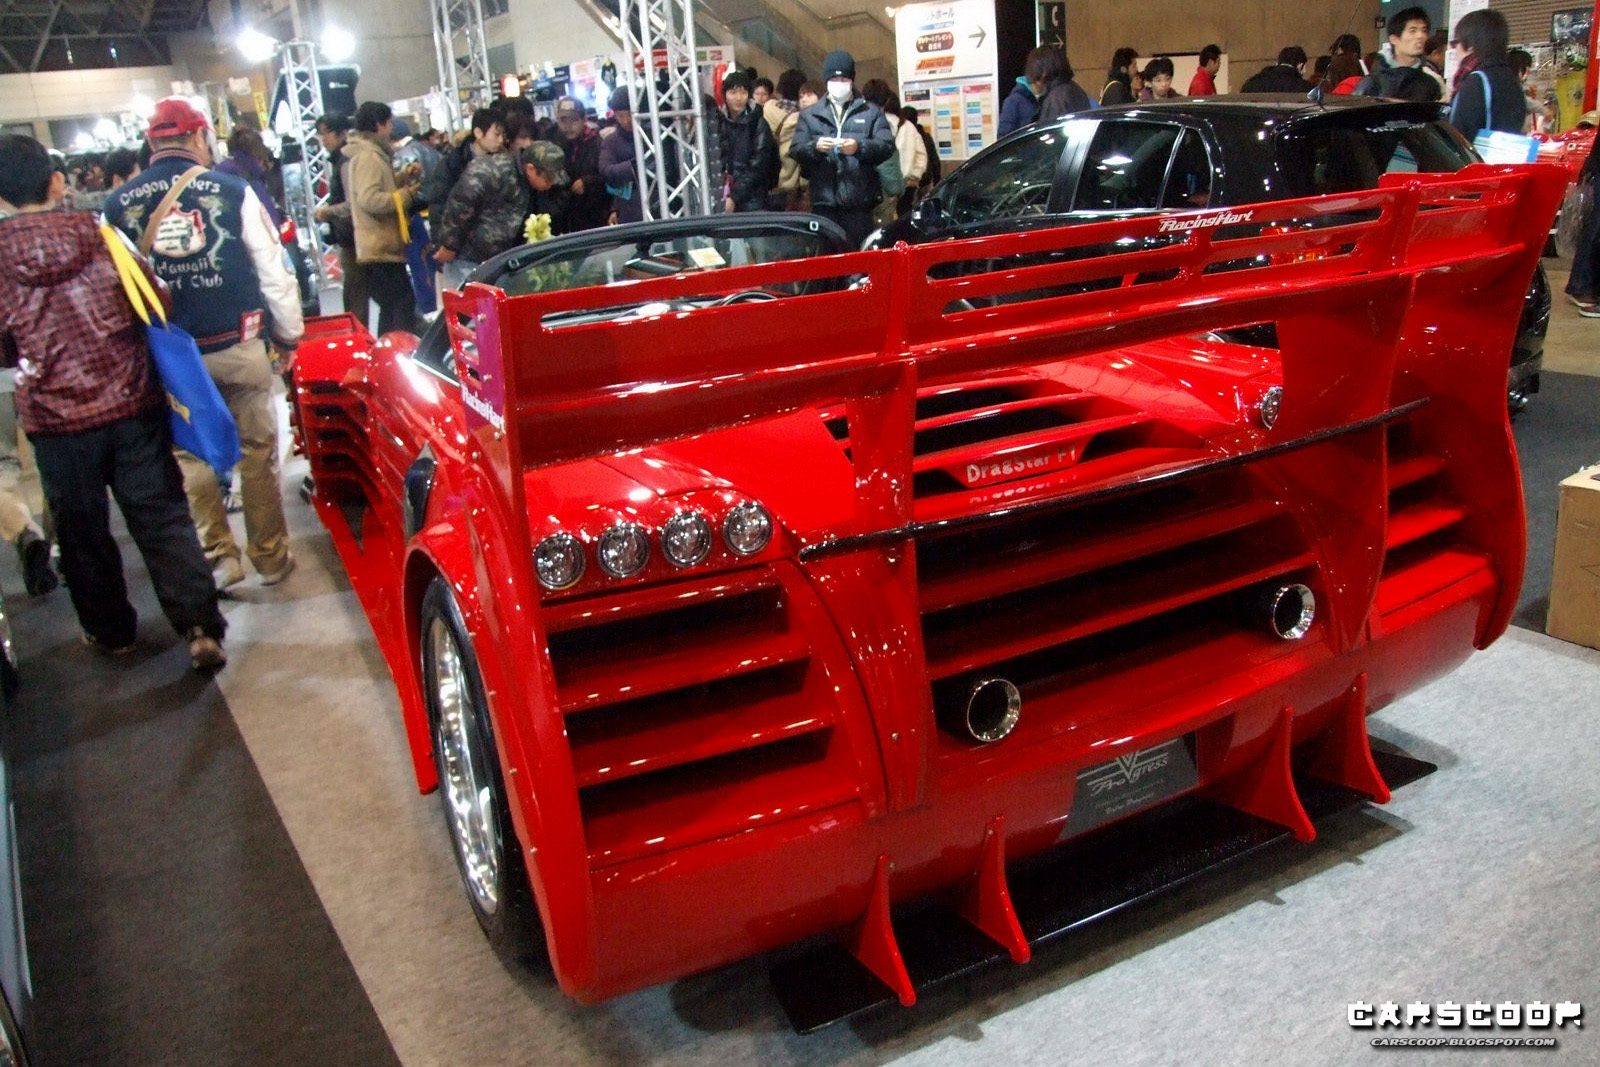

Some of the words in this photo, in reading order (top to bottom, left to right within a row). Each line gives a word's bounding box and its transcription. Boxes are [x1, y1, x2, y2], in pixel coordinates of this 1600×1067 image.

[171, 174, 220, 193] Rders
[1158, 210, 1254, 233] RacingHart
[191, 273, 223, 288] Club
[966, 454, 1050, 483] DragStar
